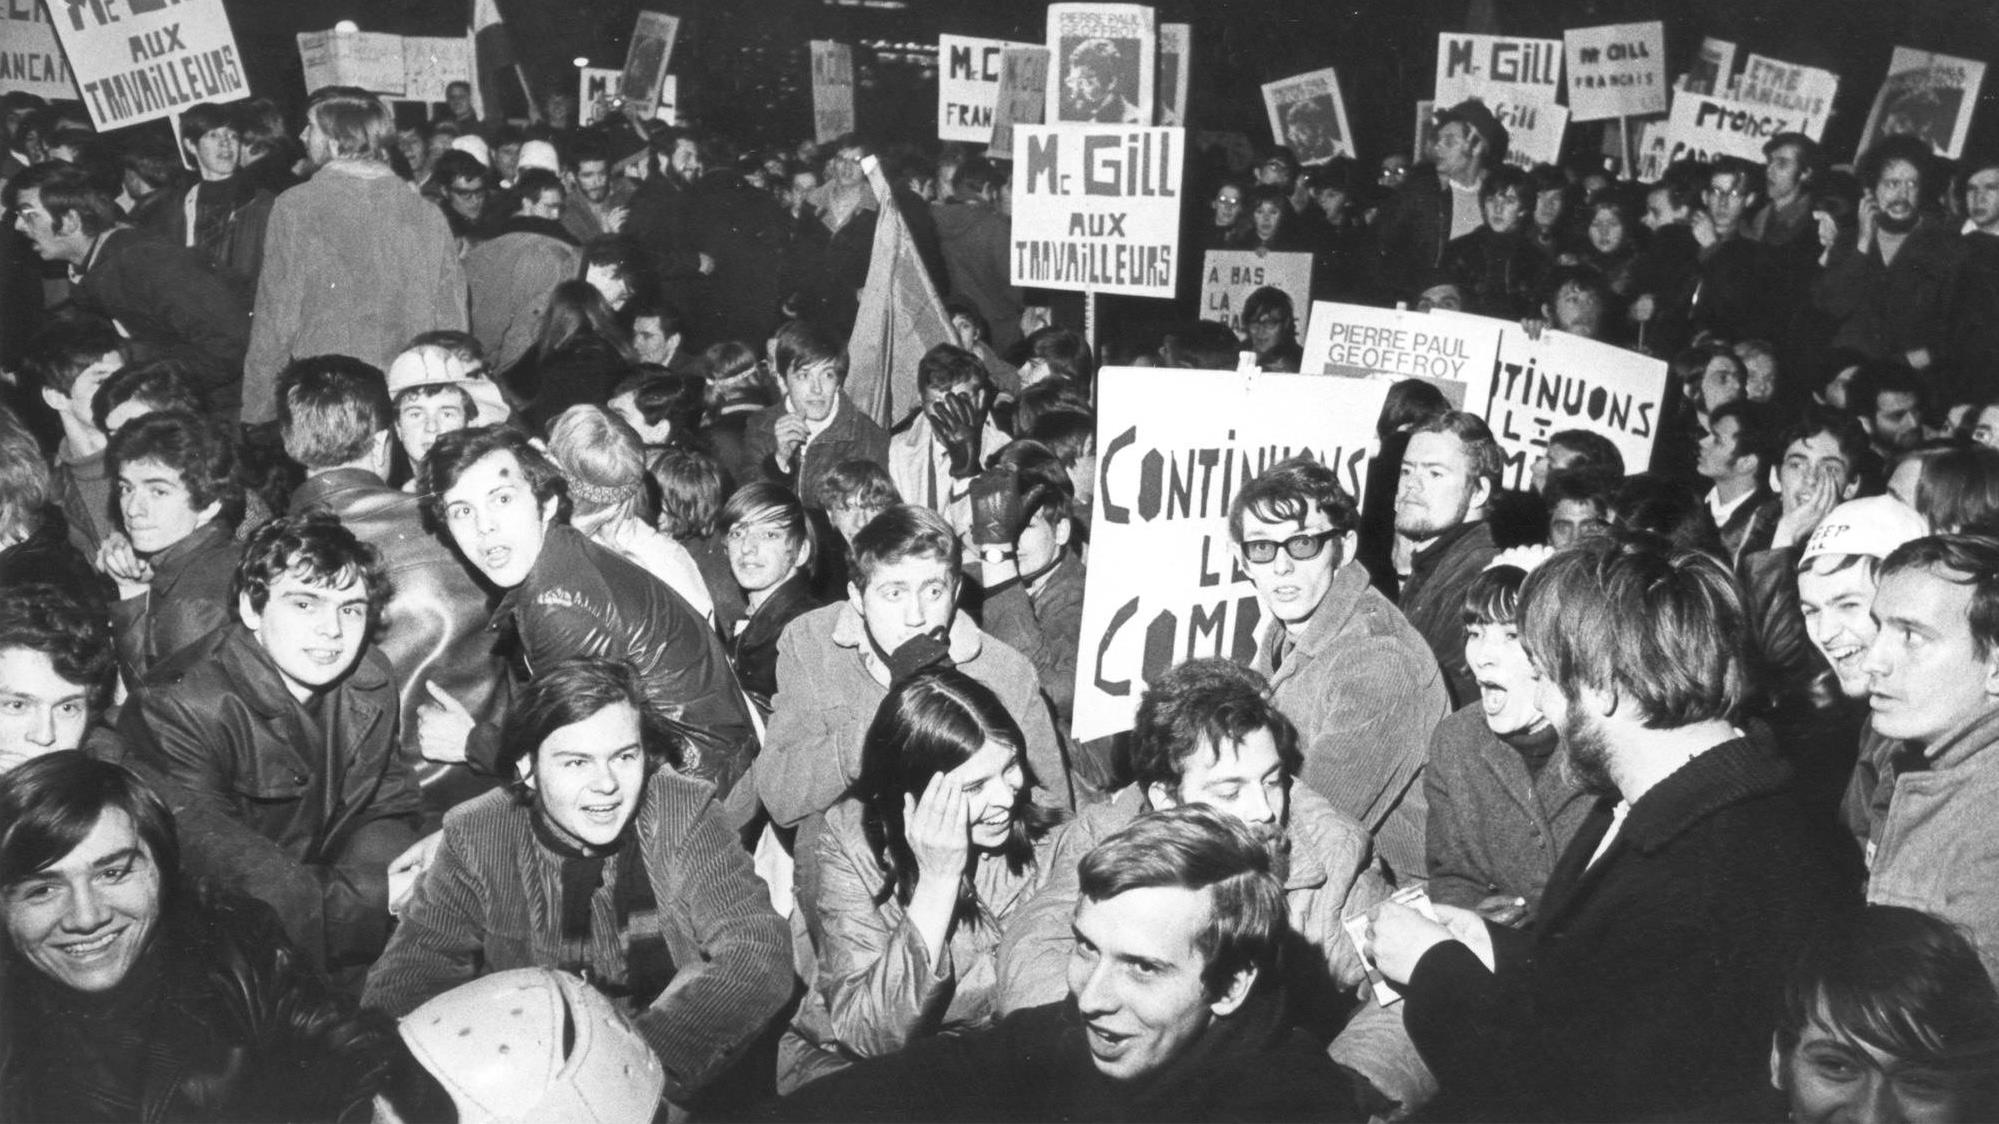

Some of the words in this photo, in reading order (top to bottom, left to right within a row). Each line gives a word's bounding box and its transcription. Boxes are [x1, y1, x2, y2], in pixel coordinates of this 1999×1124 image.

[128, 22, 186, 63] AUX
[946, 102, 992, 127] FRAN
[1069, 212, 1127, 238] AUX
[1209, 292, 1229, 311] LA
[1329, 322, 1408, 350] PIERRE
[1413, 333, 1470, 360] PAUL
[1328, 343, 1465, 379] GEOFFROY
[1094, 596, 1262, 696] COMB
